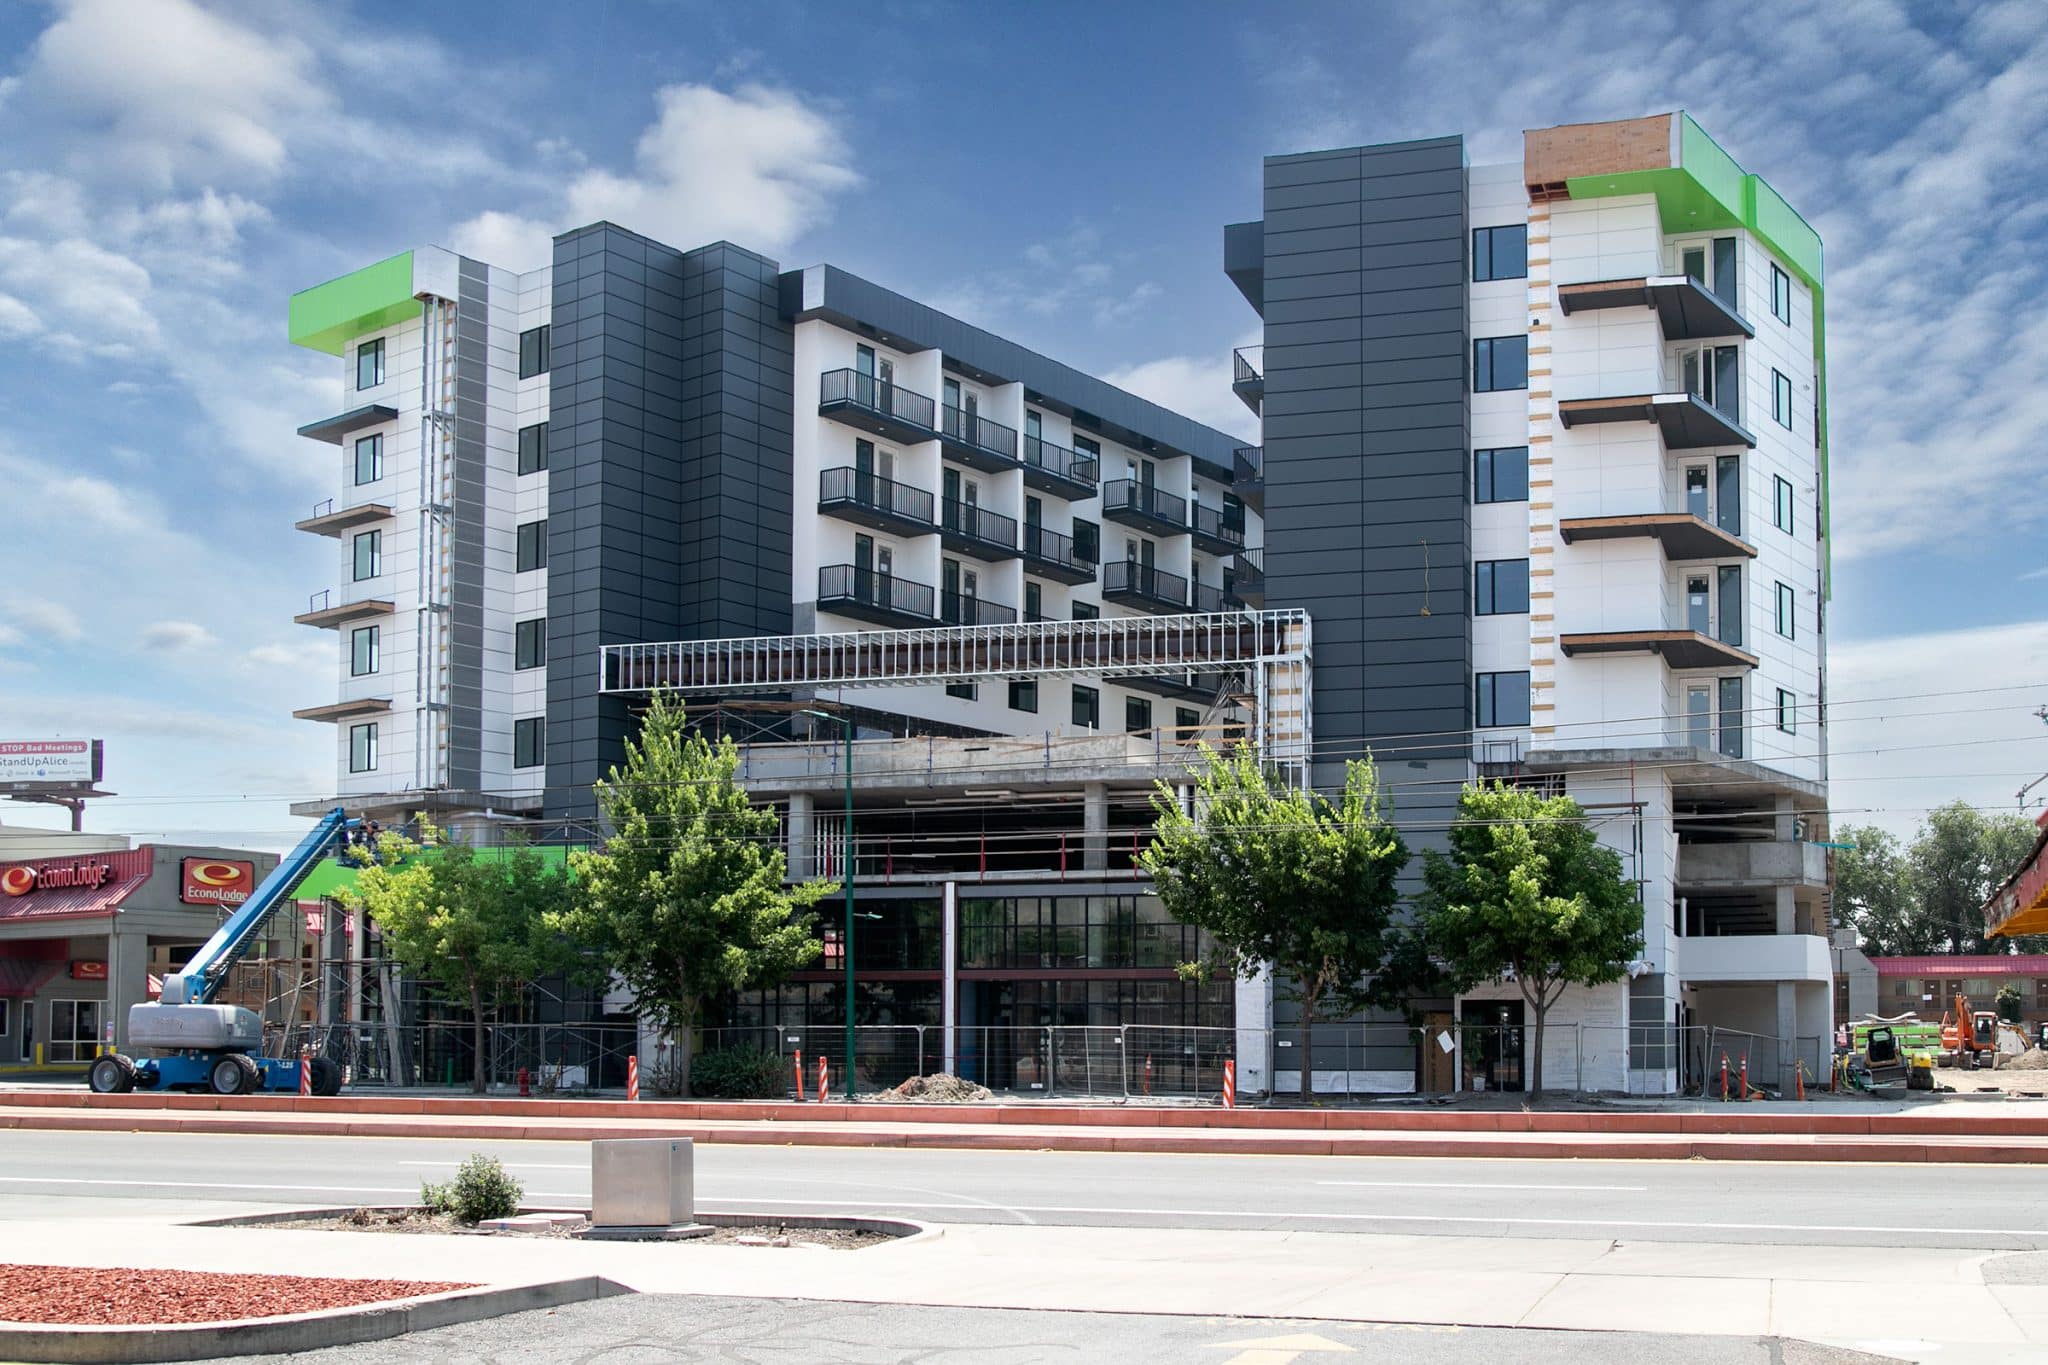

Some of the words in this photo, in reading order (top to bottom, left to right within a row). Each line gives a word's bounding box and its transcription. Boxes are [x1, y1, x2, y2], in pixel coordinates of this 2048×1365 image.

[2, 744, 23, 752] STOP
[26, 743, 42, 752] Bad
[45, 742, 82, 752] Meetings
